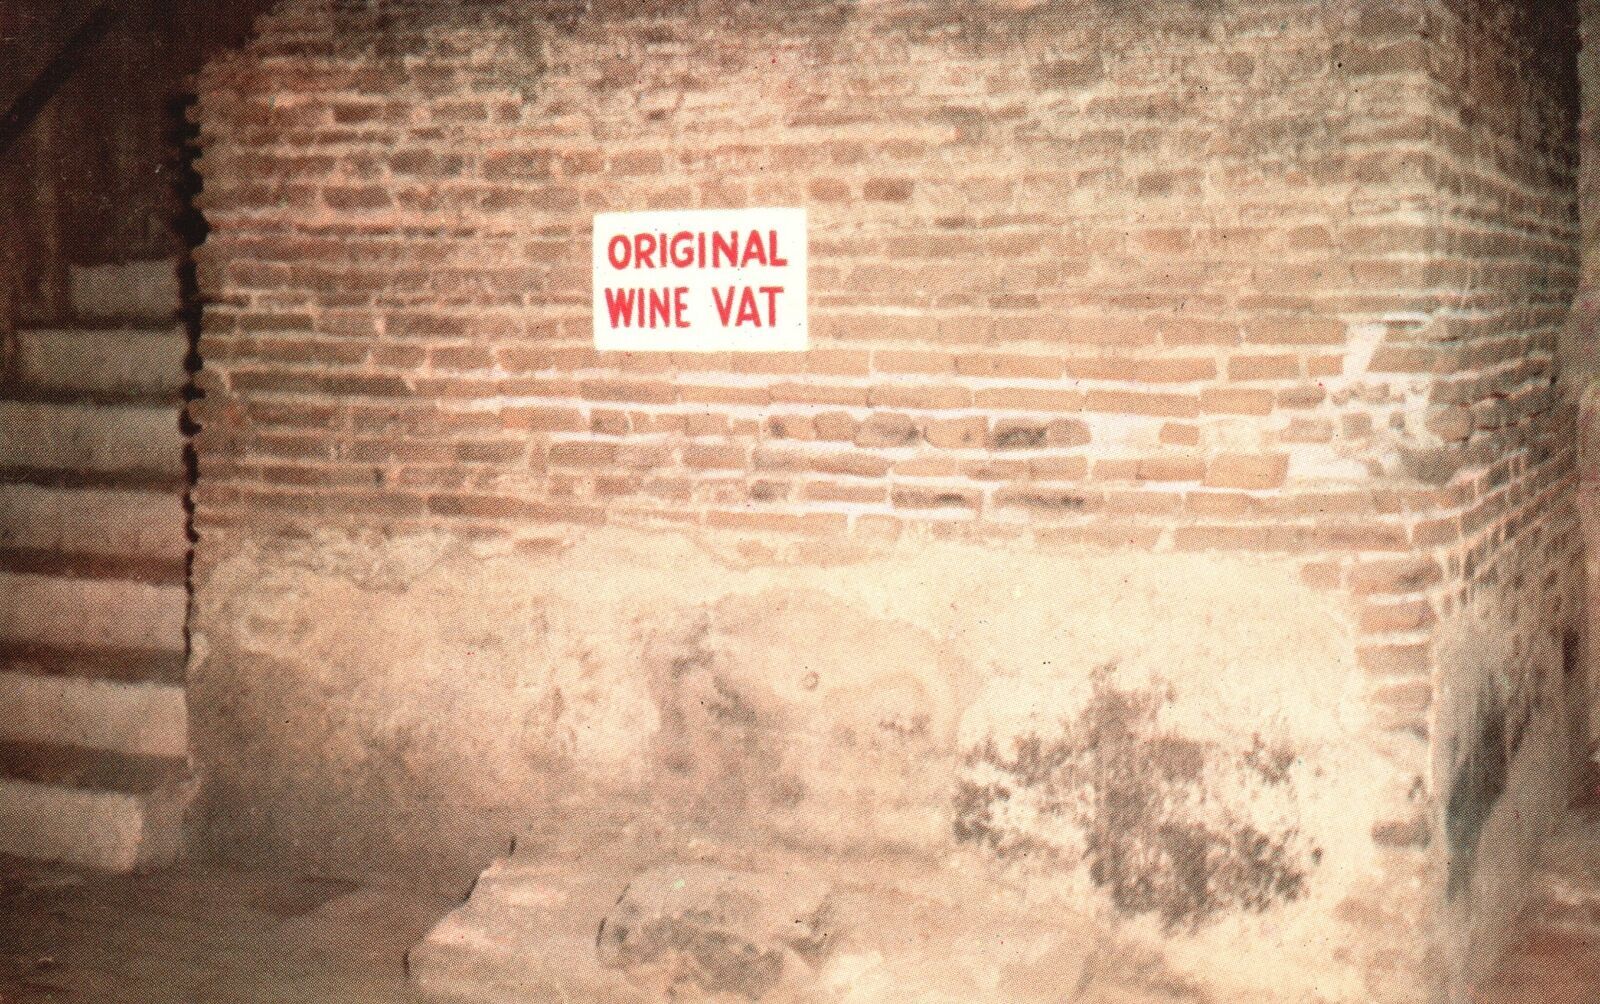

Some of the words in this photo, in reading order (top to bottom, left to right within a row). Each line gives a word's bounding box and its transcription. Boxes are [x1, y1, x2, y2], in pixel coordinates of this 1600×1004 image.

[607, 229, 788, 270] ORIGINAL
[604, 286, 691, 329] WINE
[711, 285, 785, 328] VAT
